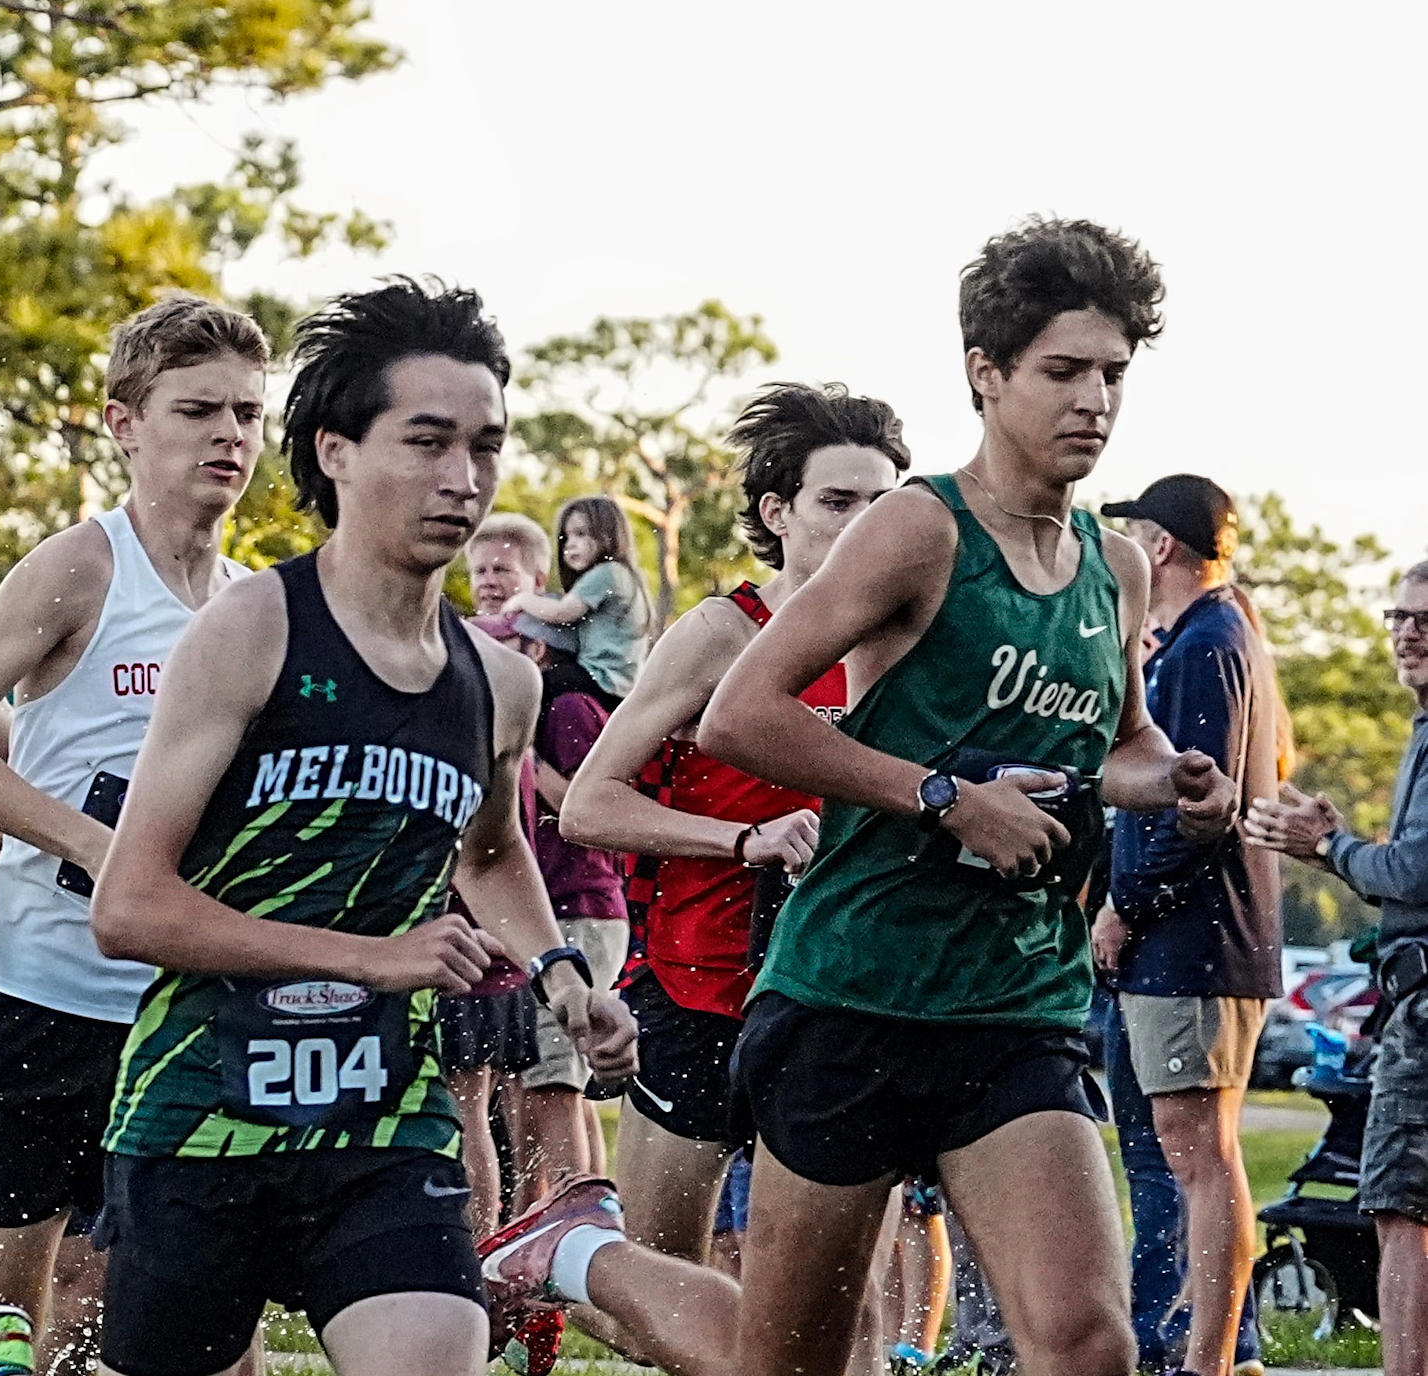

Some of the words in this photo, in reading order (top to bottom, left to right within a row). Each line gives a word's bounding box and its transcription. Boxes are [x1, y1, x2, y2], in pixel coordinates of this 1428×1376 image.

[988, 644, 1101, 725] Viera
[272, 988, 316, 1005] Track
[247, 1035, 389, 1106] 204
